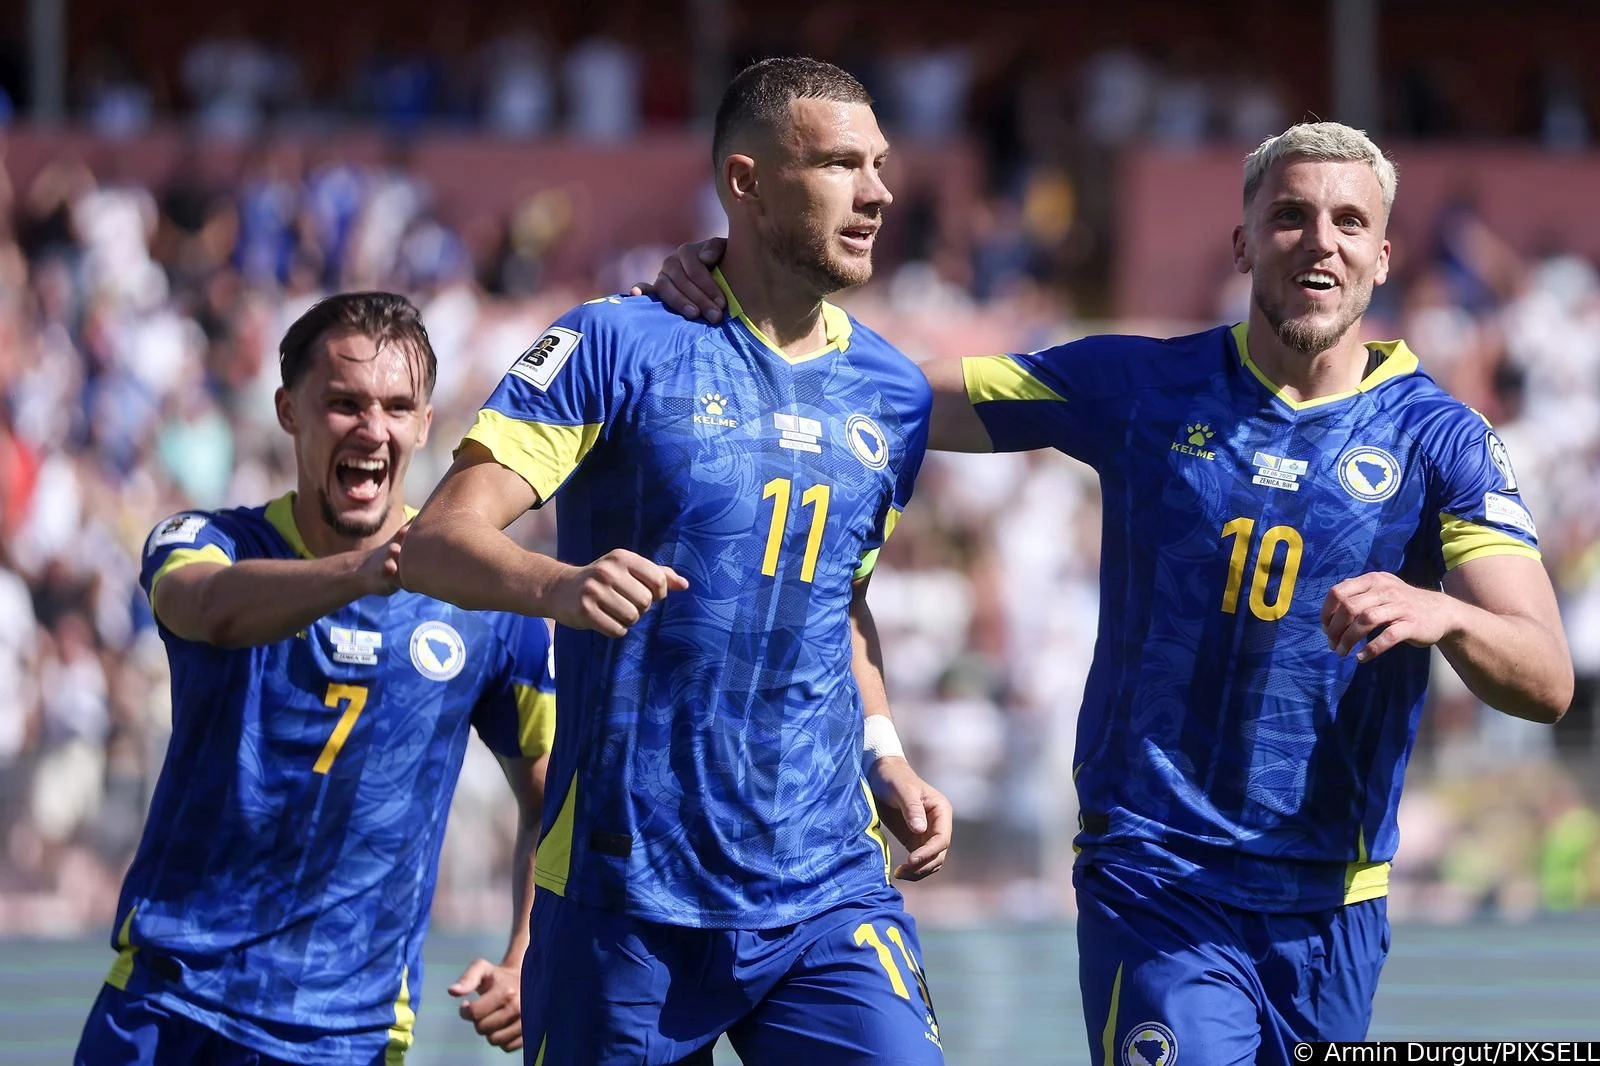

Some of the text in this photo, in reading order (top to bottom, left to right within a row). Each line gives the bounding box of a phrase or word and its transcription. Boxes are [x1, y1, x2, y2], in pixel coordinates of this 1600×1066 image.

[693, 415, 738, 428] KELME
[1171, 442, 1216, 461] KELME
[761, 477, 831, 584] 11
[1220, 516, 1304, 621] 10
[312, 682, 368, 775] 7
